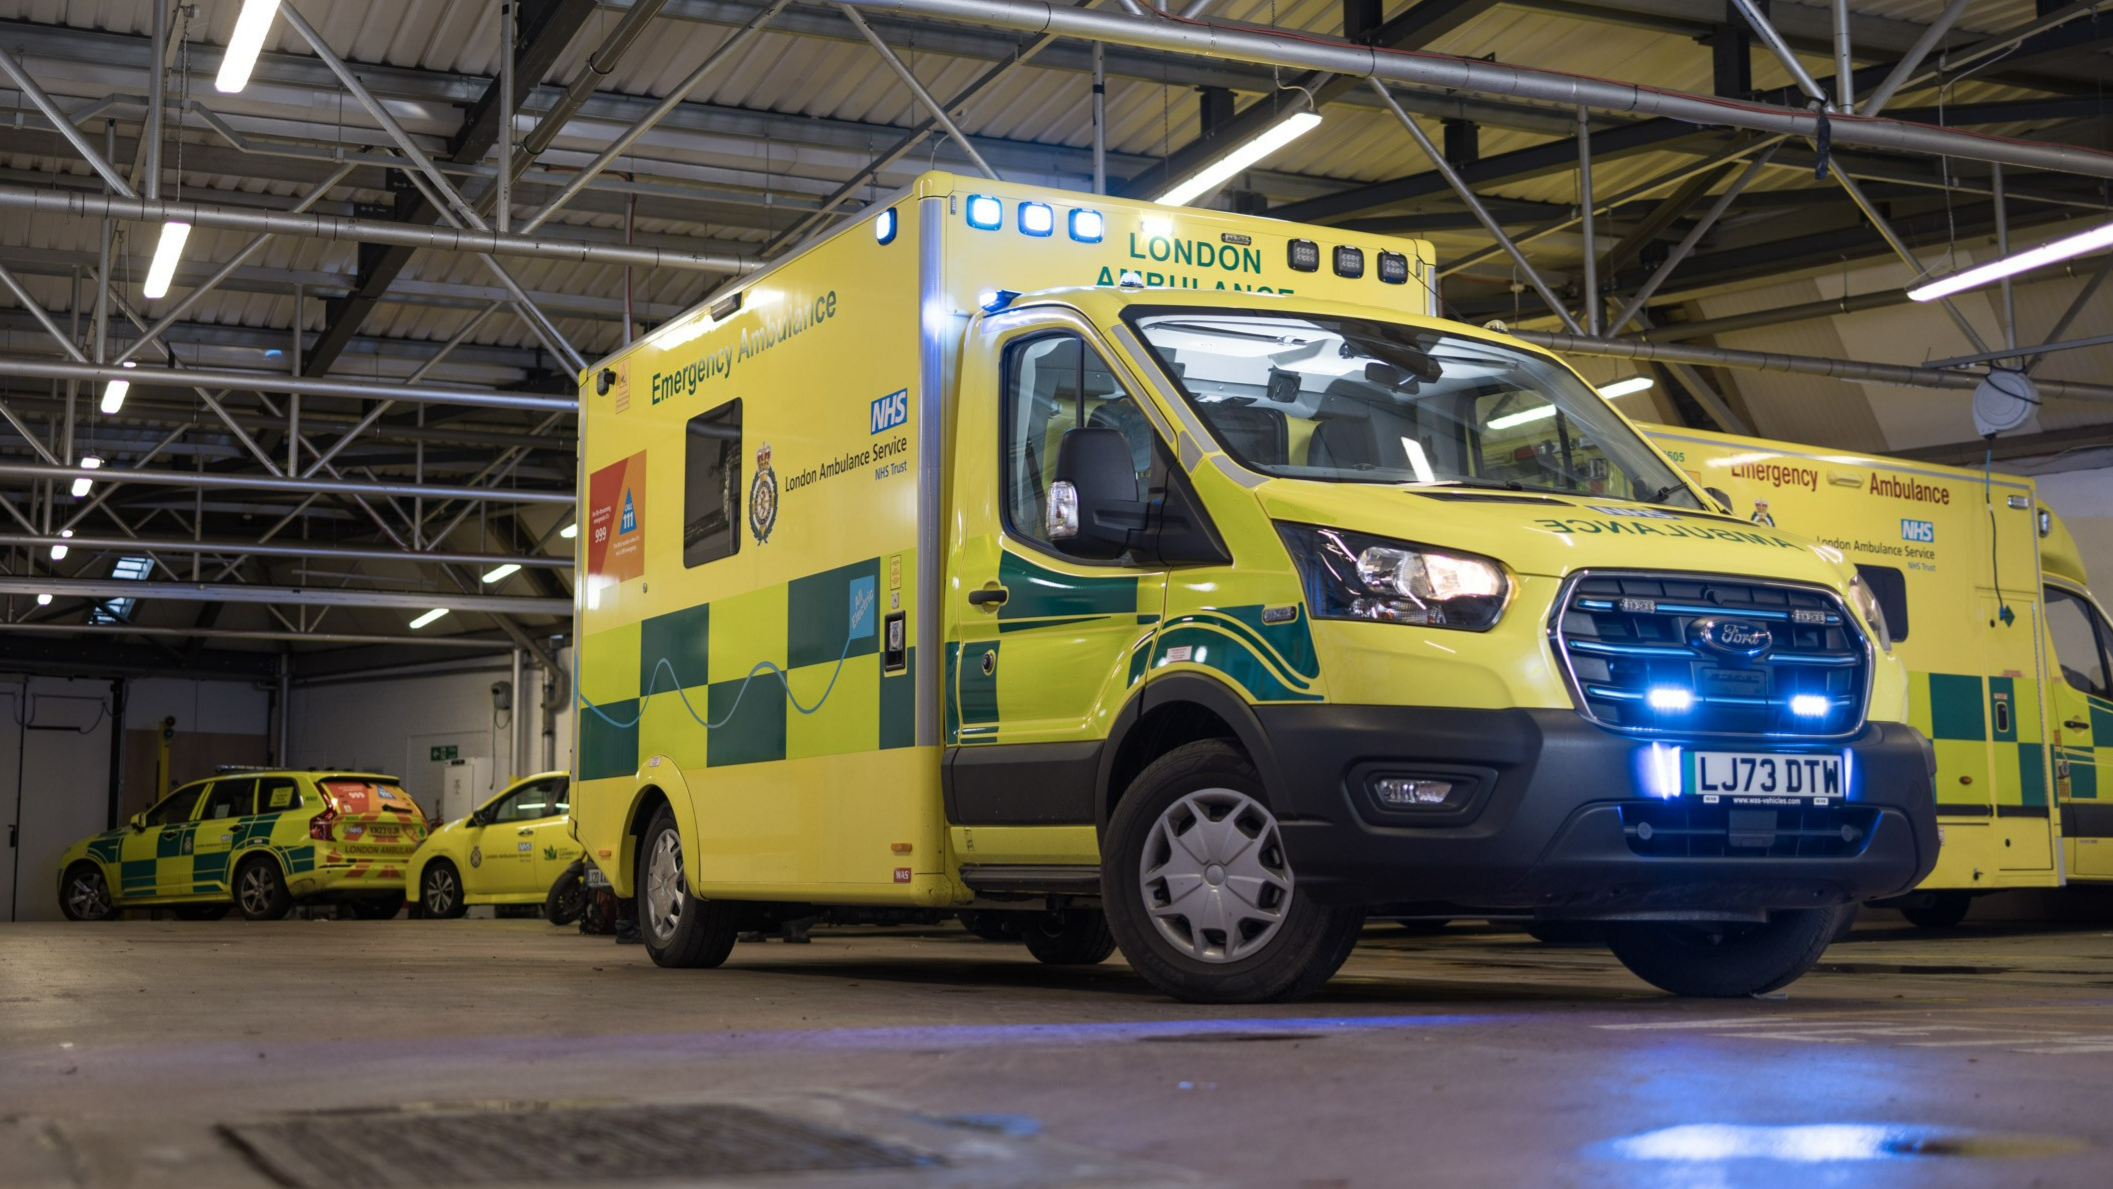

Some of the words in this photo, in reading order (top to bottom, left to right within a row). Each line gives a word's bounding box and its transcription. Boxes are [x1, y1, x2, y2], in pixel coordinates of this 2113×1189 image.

[1130, 232, 1261, 274] LONDON
[652, 344, 735, 405] Emergency
[738, 290, 837, 363] Ambulance
[871, 390, 907, 434] NHS
[785, 469, 817, 492] London
[819, 453, 870, 480] Ambulance
[873, 435, 907, 462] Service
[875, 465, 889, 480] NHS
[891, 460, 907, 475] Trust
[1731, 454, 1818, 492] Emergency
[1869, 472, 1950, 505] Ambulance
[623, 511, 634, 529] 111
[1902, 520, 1933, 542] NHS
[595, 526, 606, 543] 999
[1853, 540, 1903, 557] Ambulance
[1904, 545, 1935, 560] Service
[1908, 561, 1921, 571] NHS
[1922, 563, 1937, 572] Trust
[852, 589, 874, 629] Electric
[1721, 624, 1761, 645] Ford
[1700, 757, 1777, 792] LJ73
[1785, 759, 1839, 794] DTW
[895, 870, 909, 880] WAS
